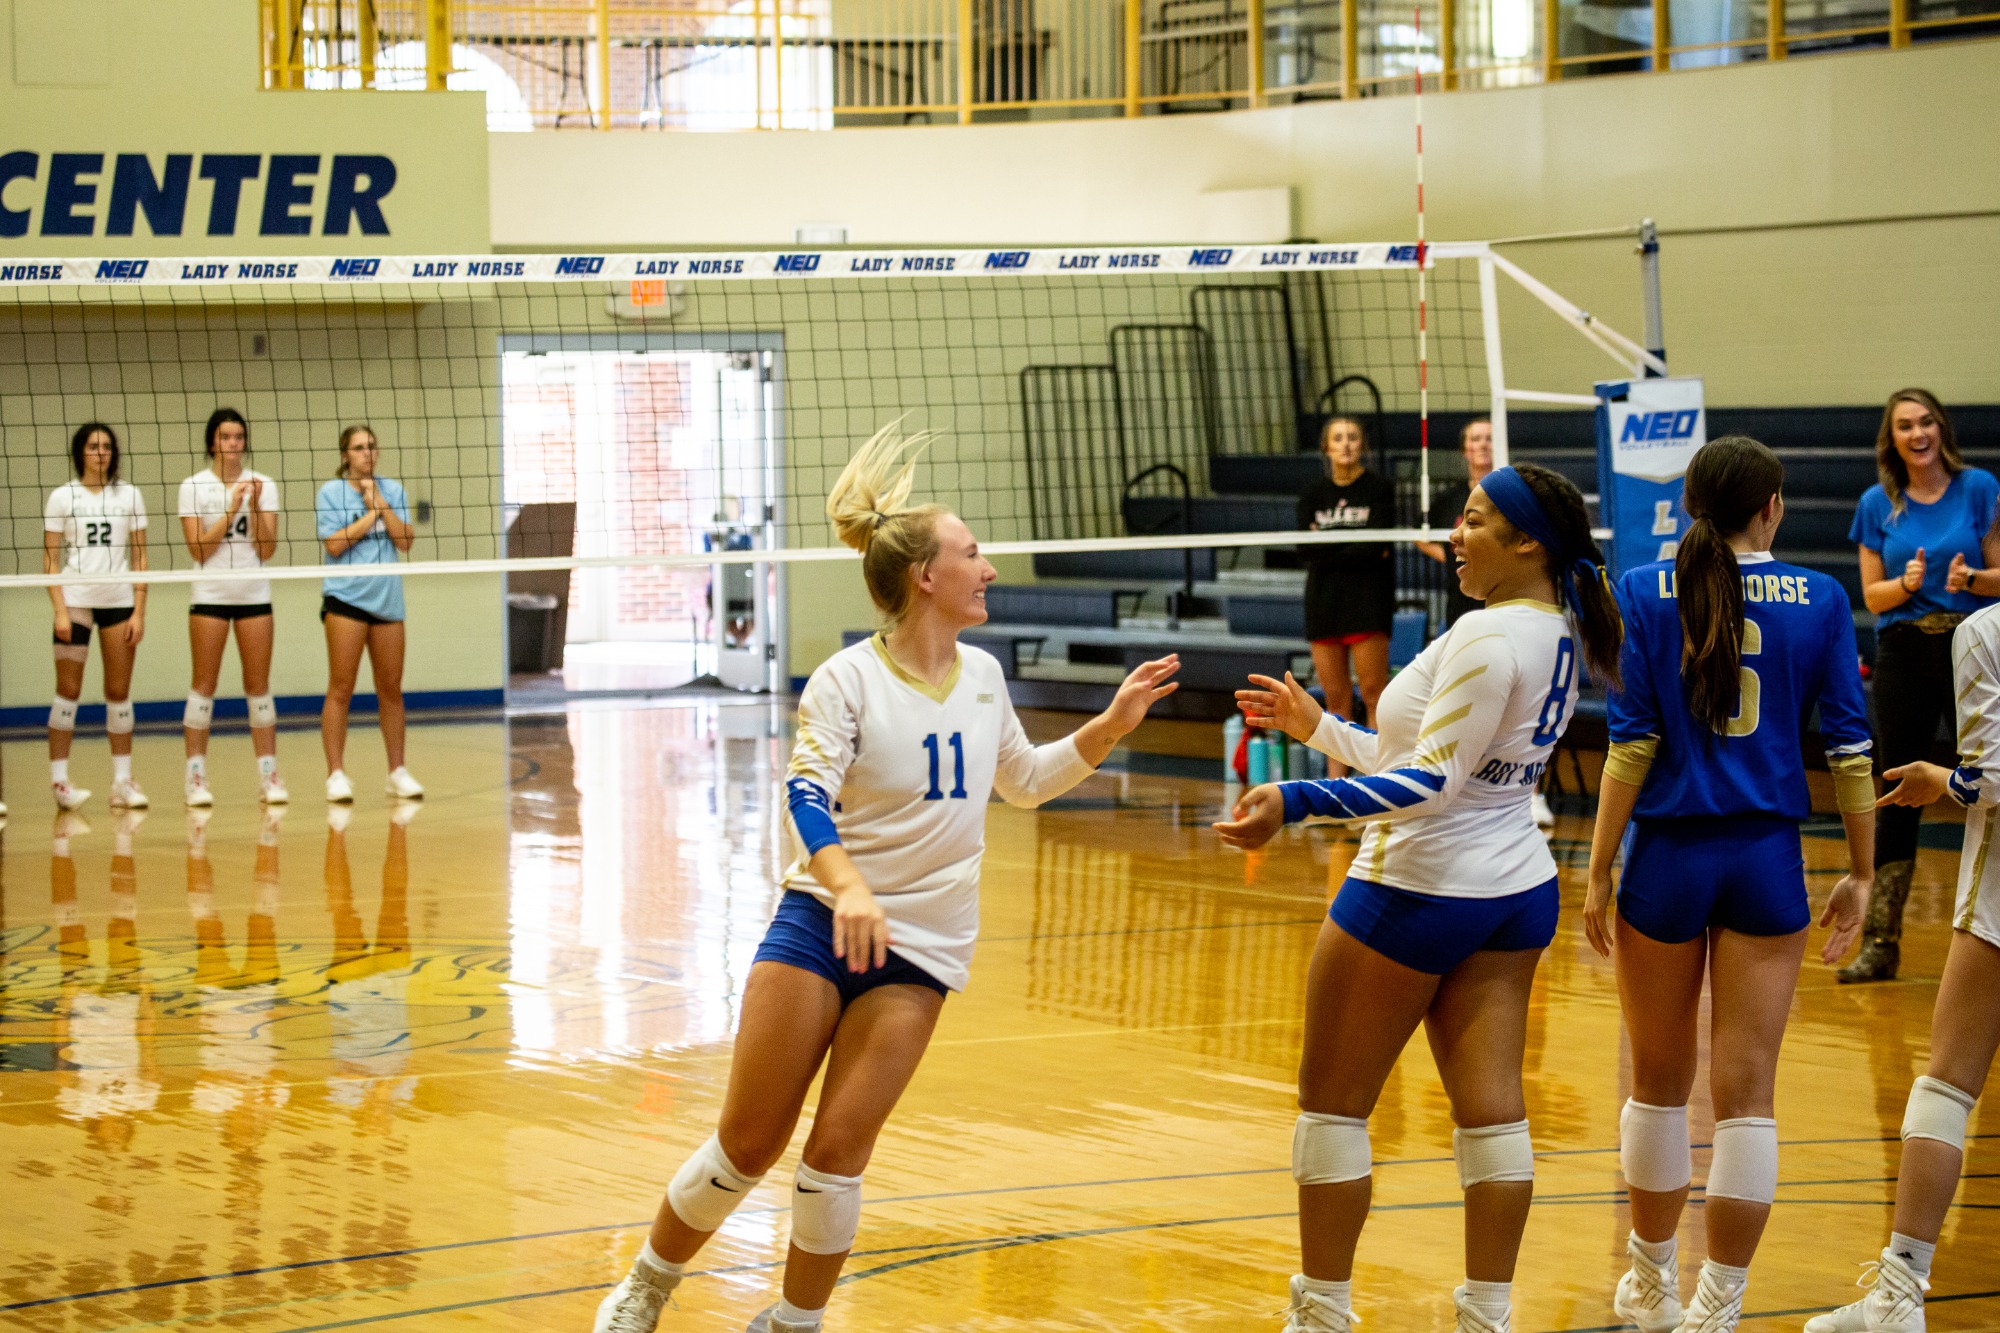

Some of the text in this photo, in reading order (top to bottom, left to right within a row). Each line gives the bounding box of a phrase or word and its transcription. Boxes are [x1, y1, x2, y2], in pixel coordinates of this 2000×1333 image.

[0, 151, 397, 238] CENTER
[1, 265, 63, 280] NORSE
[95, 260, 149, 278] NEO
[181, 265, 229, 279] LADY
[238, 264, 298, 278] NORSE
[329, 259, 381, 276] NEO
[413, 263, 458, 277] LADY
[467, 262, 525, 276] NORSE
[555, 257, 605, 274] NEO
[635, 261, 679, 275] LADY
[688, 260, 744, 274] NORSE
[774, 254, 821, 271] NEO
[851, 258, 893, 272] LADY
[901, 257, 956, 271] NORSE
[984, 252, 1031, 268] NEO
[1058, 255, 1100, 269] LADY
[1108, 254, 1160, 268] NORSE
[1188, 249, 1233, 265] NEO
[1260, 252, 1300, 265] LADY
[1308, 251, 1359, 265] NORSE
[1620, 409, 1699, 442] NEO
[86, 523, 112, 545] 22
[1742, 574, 1810, 605] ORSE
[1531, 635, 1574, 746] 8
[922, 731, 967, 800] 11
